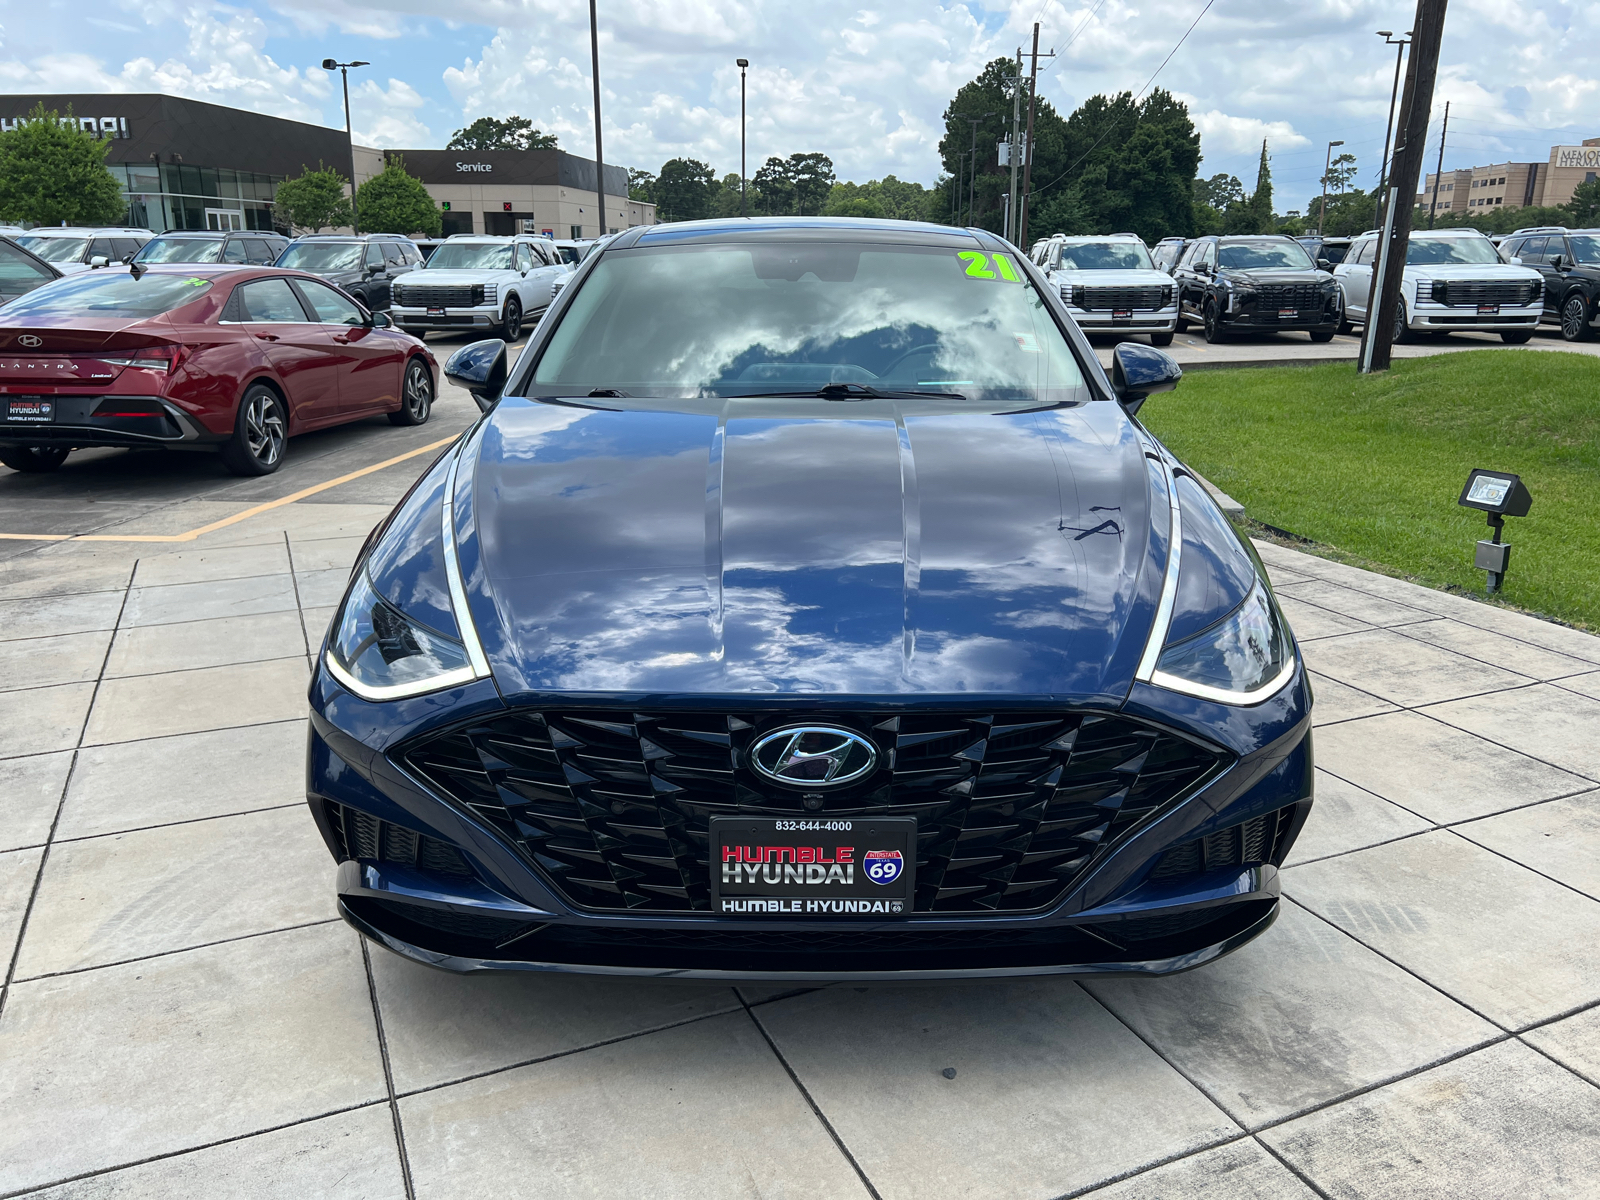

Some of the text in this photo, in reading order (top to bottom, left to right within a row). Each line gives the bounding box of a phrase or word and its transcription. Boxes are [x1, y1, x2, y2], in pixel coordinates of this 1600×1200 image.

[456, 161, 492, 172] Service
[957, 251, 1020, 282] 21
[182, 277, 208, 287] 24
[775, 821, 852, 831] 832-644-4000
[722, 846, 854, 863] HUMBLE
[722, 863, 854, 885] HYUNDAI
[869, 862, 897, 878] 69
[722, 901, 802, 912] HUMBLE
[807, 901, 890, 913] HYUNDAI
